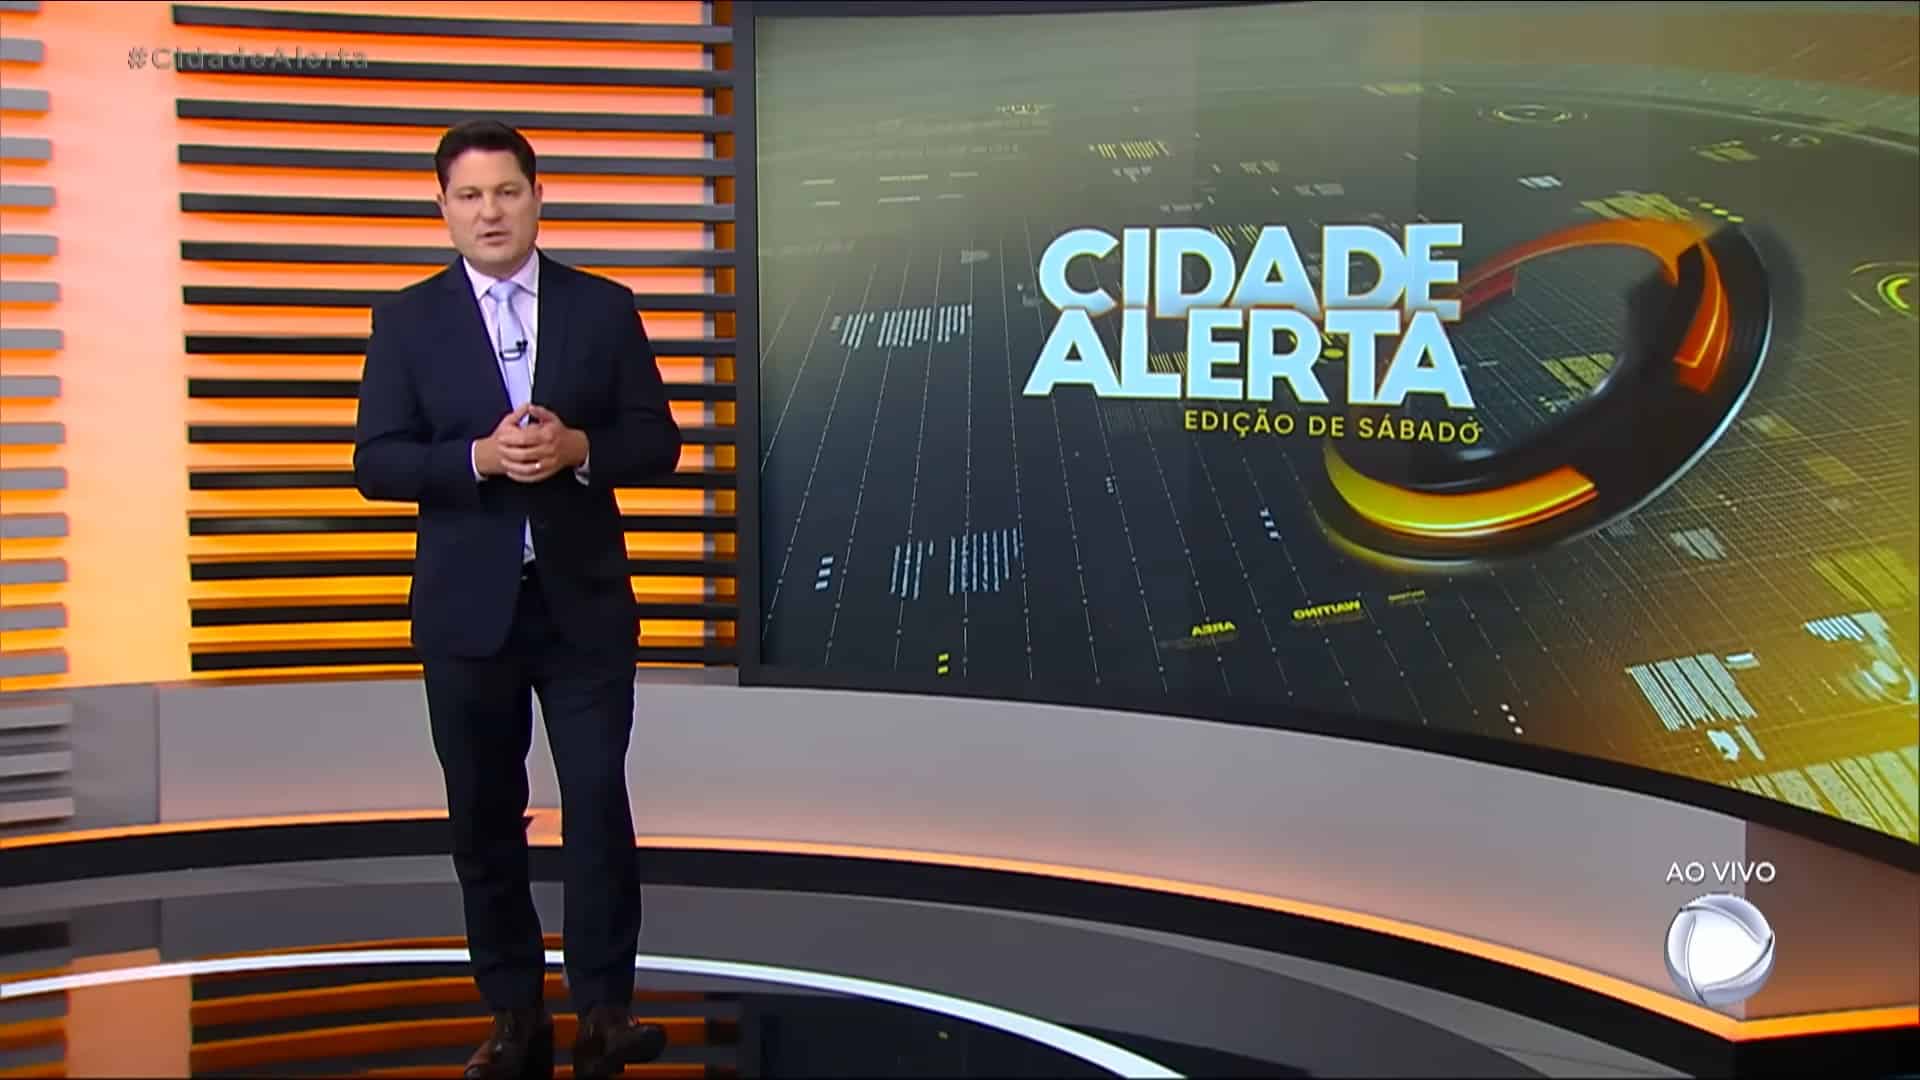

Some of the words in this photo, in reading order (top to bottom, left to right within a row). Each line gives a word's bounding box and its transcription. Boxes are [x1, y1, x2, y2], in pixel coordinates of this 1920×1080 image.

[1038, 223, 1463, 320] CIDADE
[1023, 307, 1476, 408] ALERTA
[1185, 409, 1294, 436] EDIÇÃO
[1308, 415, 1344, 437] DE
[1359, 414, 1480, 444] SÁBADO
